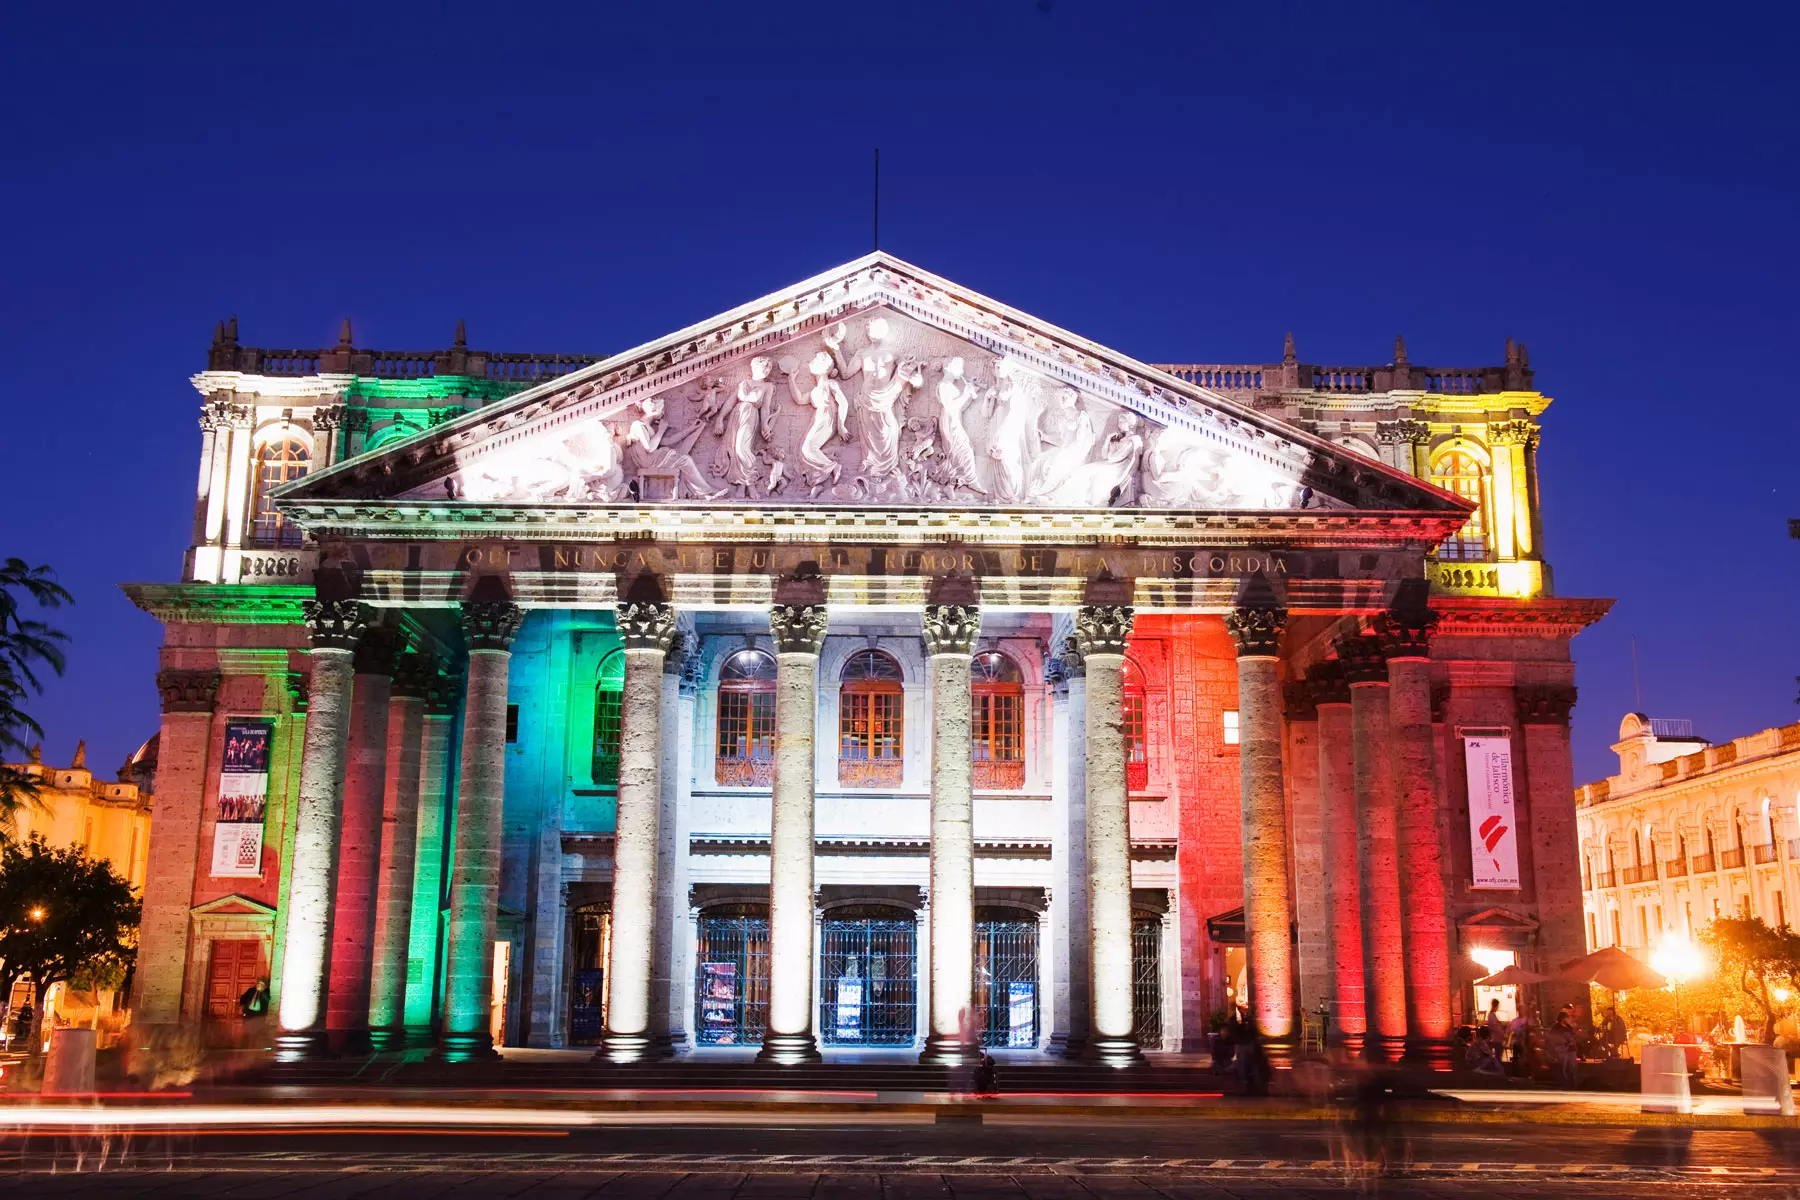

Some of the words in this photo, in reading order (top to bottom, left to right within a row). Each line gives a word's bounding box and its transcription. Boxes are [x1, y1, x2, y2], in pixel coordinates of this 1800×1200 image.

[554, 550, 648, 567] NUNCA
[819, 552, 849, 569] EL
[885, 553, 975, 570] RUMOR
[1013, 554, 1045, 571] DE
[1075, 556, 1109, 572] LA
[1143, 556, 1287, 573] DISCORDIA
[1491, 752, 1500, 763] de
[1491, 765, 1501, 793] Jalisco
[1500, 752, 1511, 805] Filarmónica
